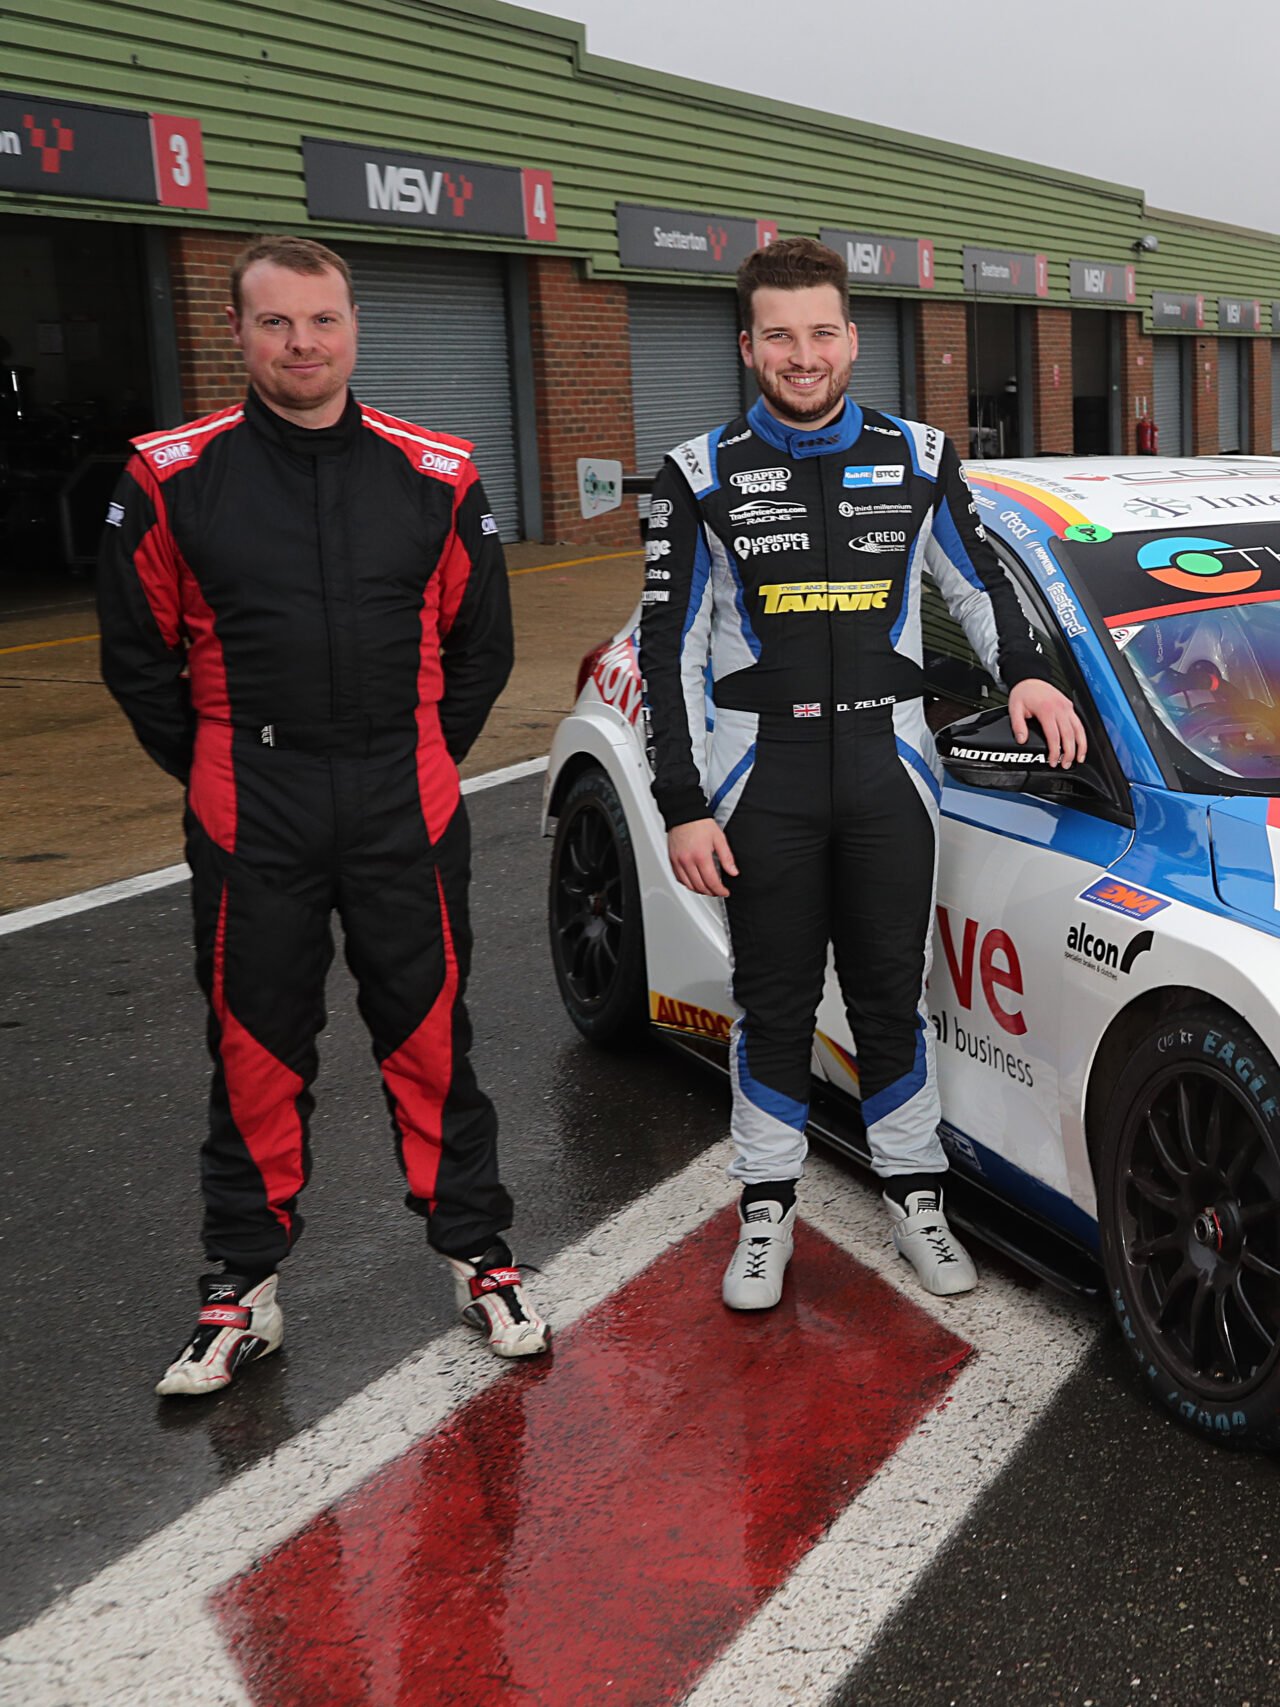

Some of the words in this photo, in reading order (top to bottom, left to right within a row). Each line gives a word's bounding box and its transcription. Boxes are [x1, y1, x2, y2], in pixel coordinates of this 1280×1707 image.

[169, 134, 191, 187] 3
[365, 162, 443, 215] MSV
[533, 183, 547, 225] 4
[653, 226, 708, 251] Snetterton
[847, 241, 882, 274] MSV
[921, 248, 931, 277] 6
[153, 443, 192, 465] OMP
[421, 451, 460, 473] OMP
[736, 469, 786, 484] DRAPER
[875, 470, 901, 479] BTCC
[741, 480, 788, 495] Tools
[729, 506, 808, 521] TradePriceCars.com
[746, 514, 792, 526] RACING
[750, 533, 809, 547] LOGISTICS
[752, 539, 810, 556] PEOPLE
[867, 531, 906, 543] CREDO
[758, 584, 889, 614] TANVIC
[594, 640, 642, 721] MOLY
[836, 703, 850, 712] D.
[854, 695, 897, 710] ZELOS
[950, 746, 1046, 764] MOTORBA
[1096, 884, 1161, 914] DNA
[1066, 921, 1119, 969] alcon
[954, 1016, 1034, 1088] business
[1202, 1029, 1280, 1123] EAGLE
